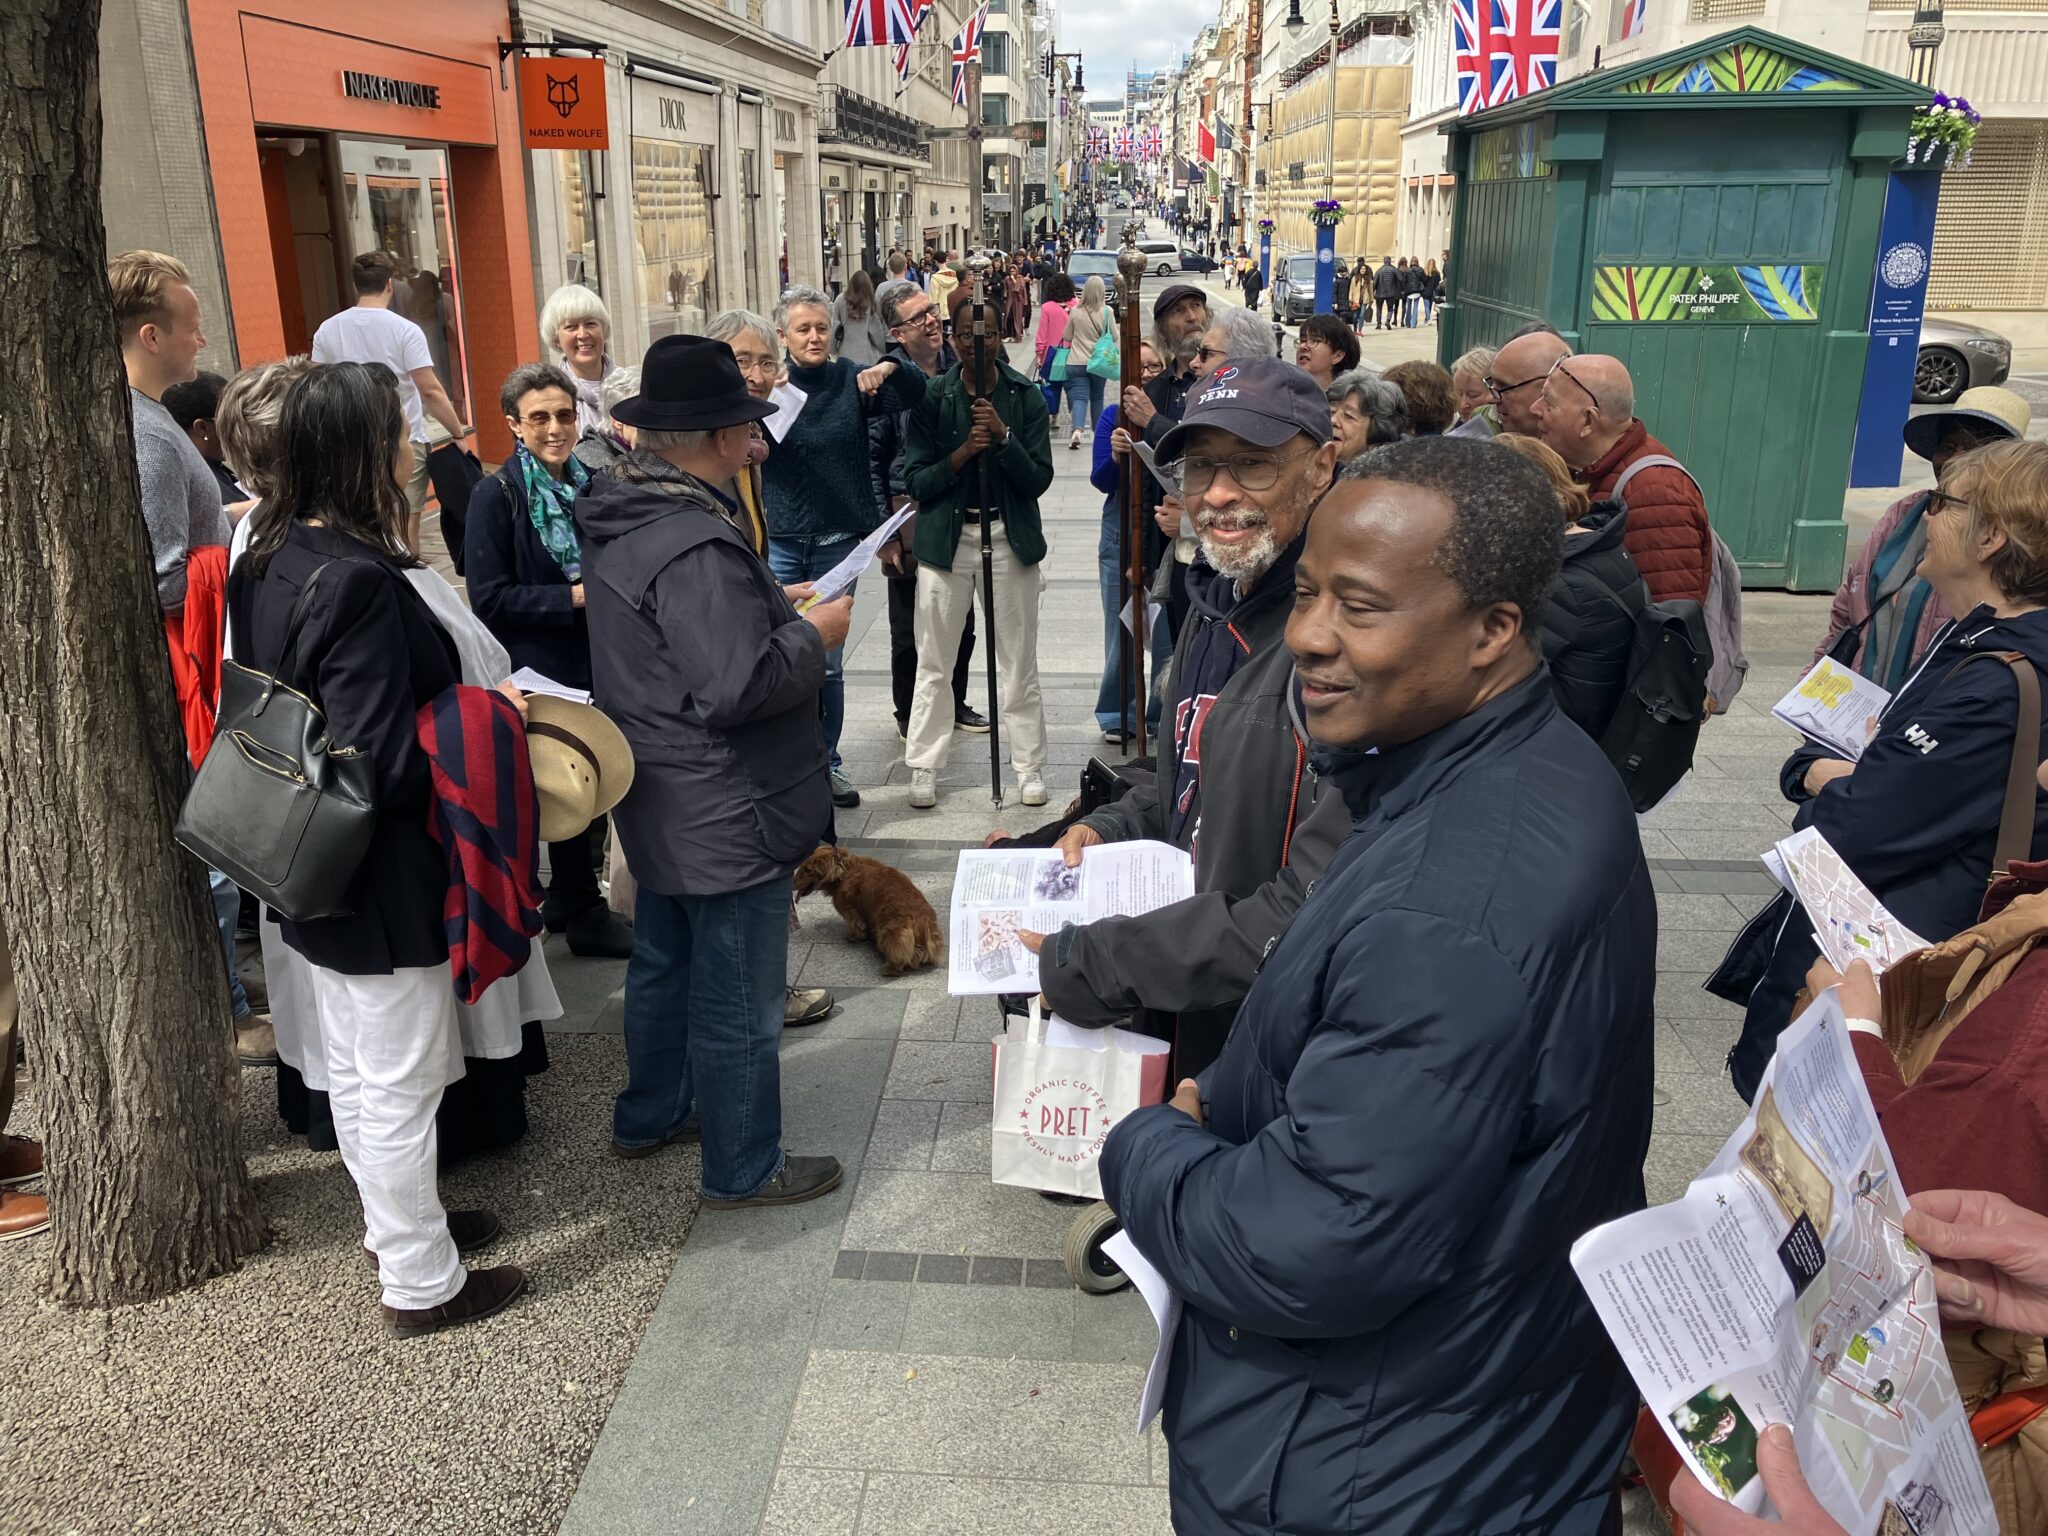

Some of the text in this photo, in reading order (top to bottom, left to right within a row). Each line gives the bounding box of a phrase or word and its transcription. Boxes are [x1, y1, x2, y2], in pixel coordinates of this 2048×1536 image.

[341, 70, 441, 109] NAKED WOLFE
[659, 96, 687, 132] DIOR
[774, 108, 796, 142] DIOR
[529, 128, 602, 138] NAKED WOLFE
[1669, 293, 1740, 304] PATEK PHILIPPE
[1198, 389, 1239, 405] PENN
[1905, 723, 1939, 754] HH
[1025, 1079, 1107, 1111] ORGANIC COFFEE
[1040, 1104, 1091, 1136] PRET
[1021, 1124, 1108, 1163] FRESHLY MADE FOOD
